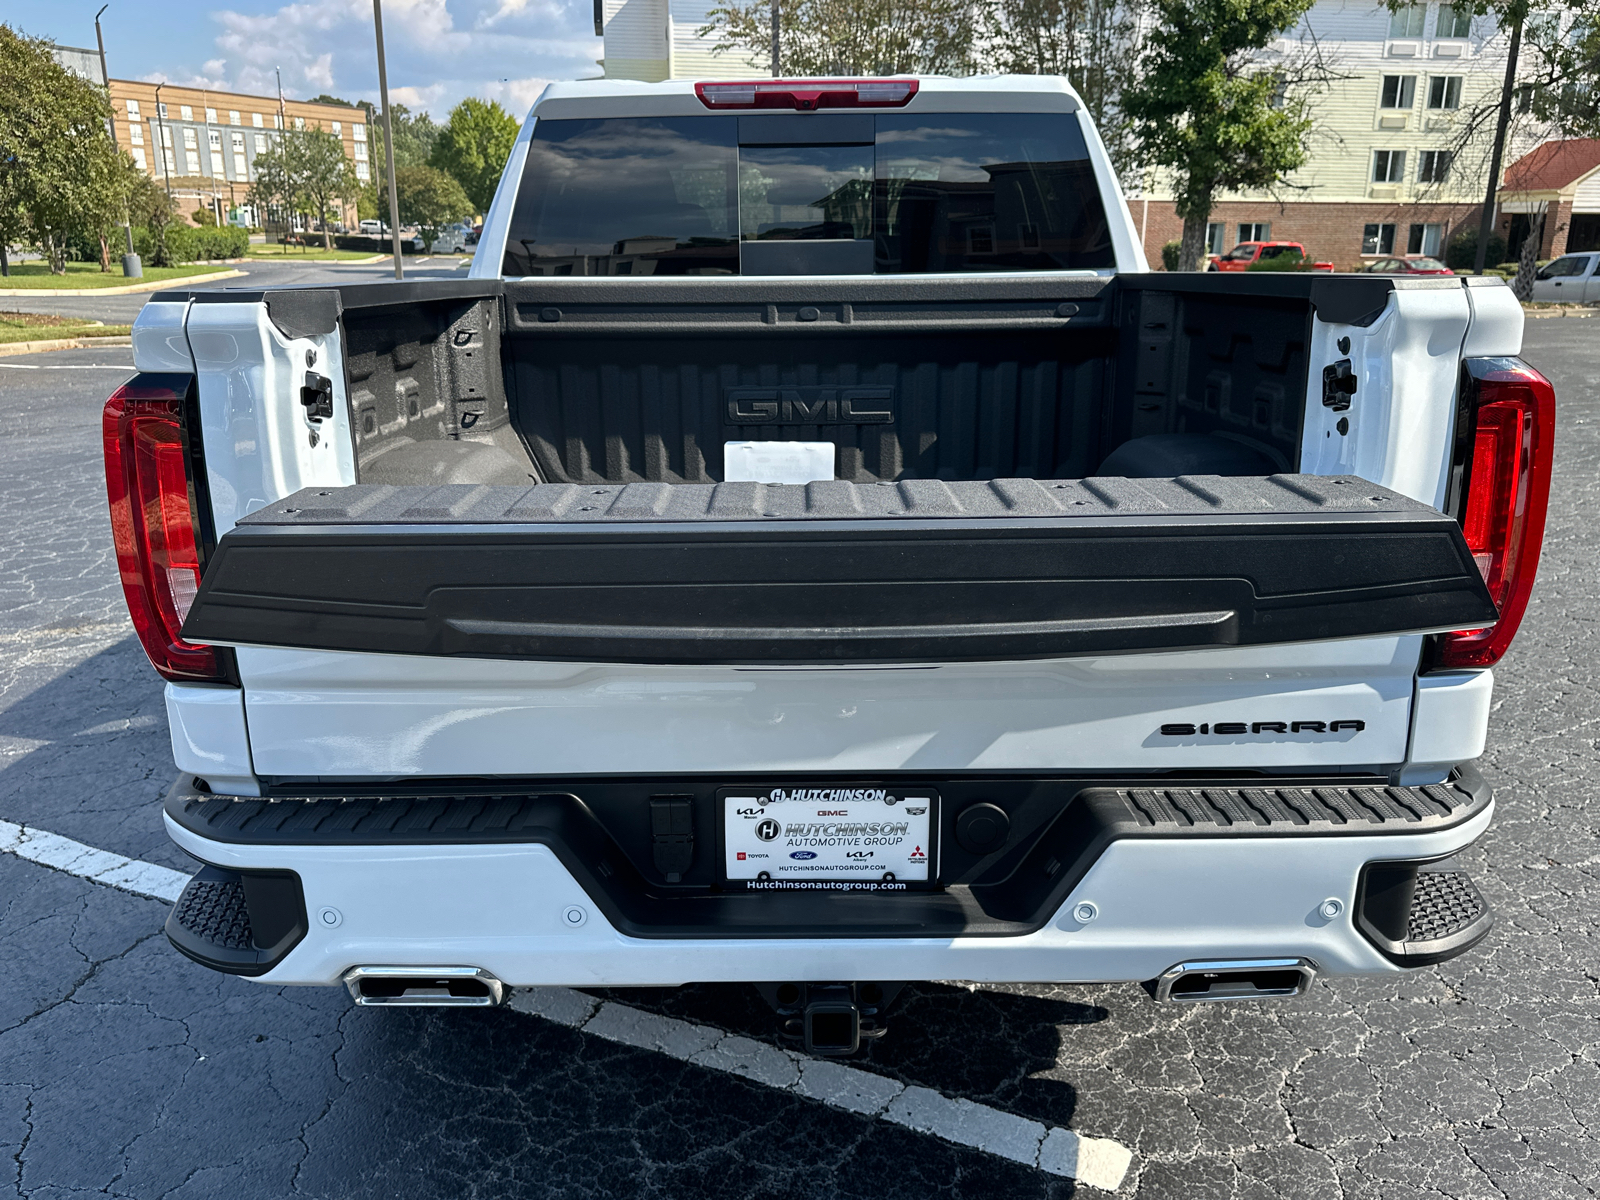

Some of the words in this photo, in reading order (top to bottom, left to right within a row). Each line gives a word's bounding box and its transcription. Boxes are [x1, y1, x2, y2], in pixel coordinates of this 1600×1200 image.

[728, 389, 892, 421] GMC
[1161, 720, 1365, 735] SIERRA
[790, 789, 886, 802] HUTCHINSON
[785, 822, 908, 837] HUTCHINSON
[787, 838, 860, 846] AUTOMOTIVE
[864, 837, 903, 846] GROUP
[794, 852, 813, 860] Ford
[747, 881, 906, 891] Hutchinsonautogroup.com
